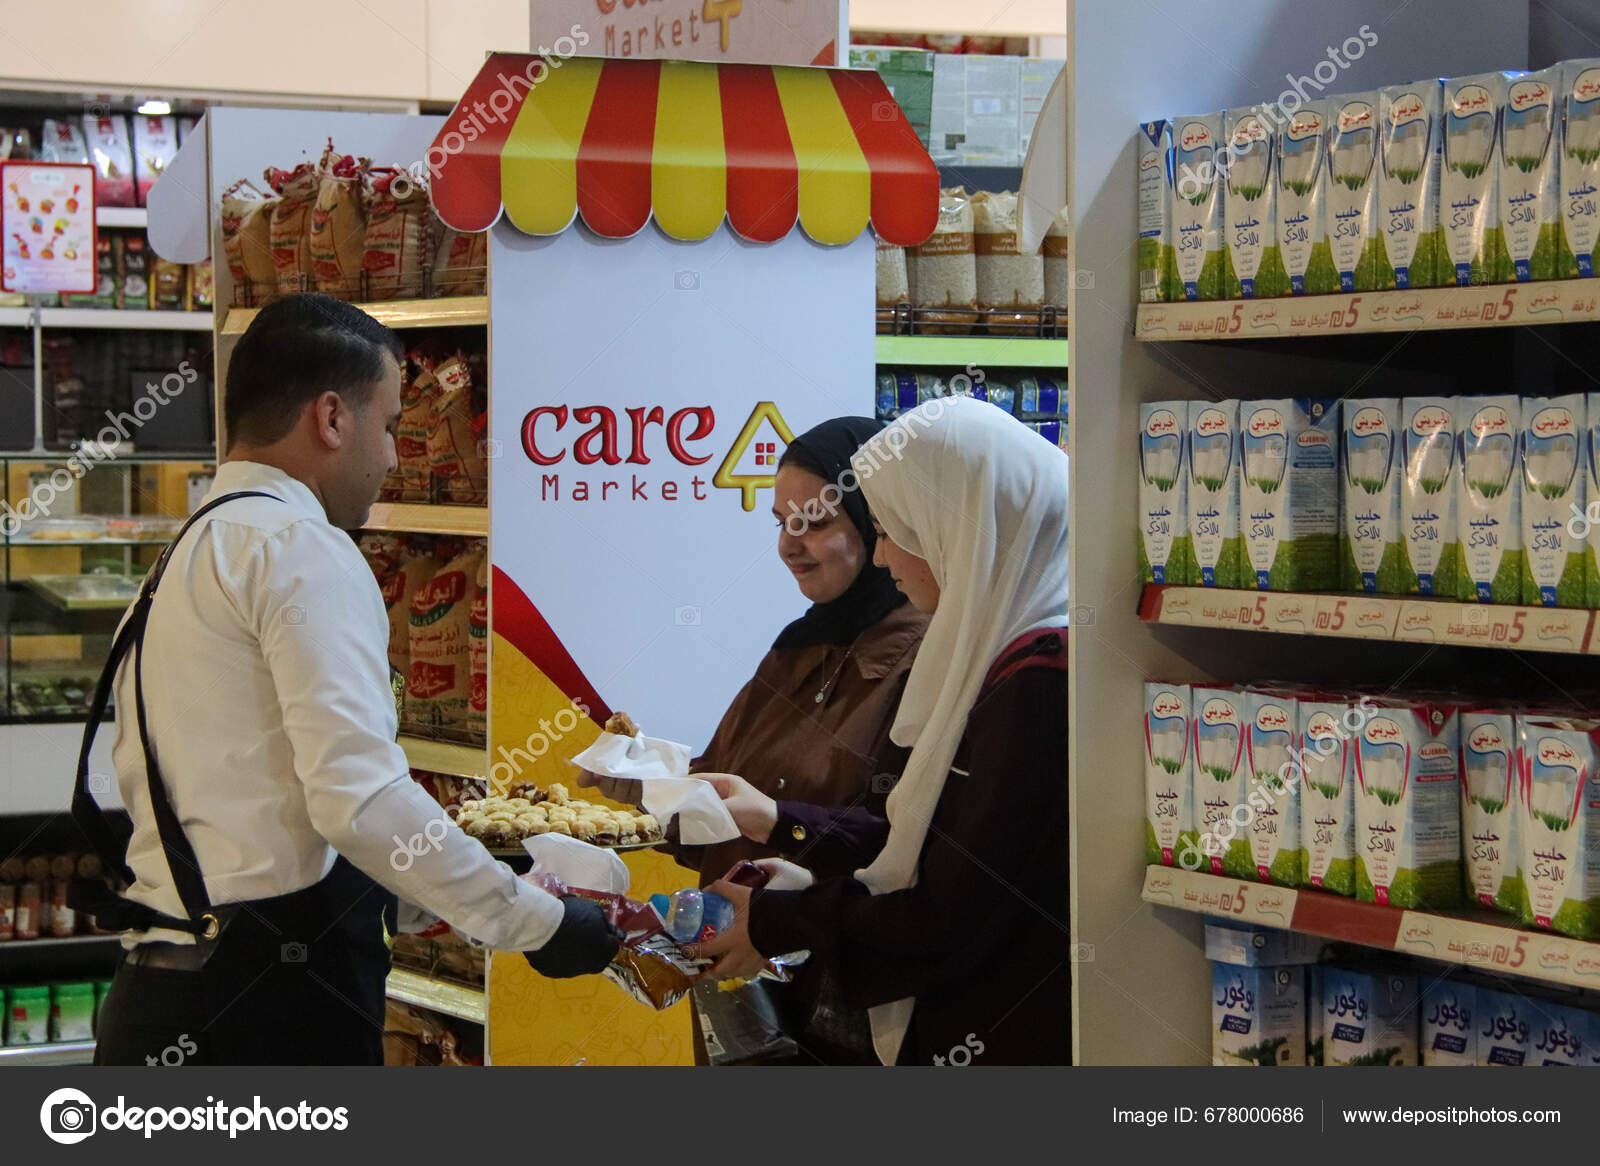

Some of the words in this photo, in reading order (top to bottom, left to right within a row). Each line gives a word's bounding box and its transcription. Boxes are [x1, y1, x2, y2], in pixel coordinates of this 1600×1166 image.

[605, 9, 700, 56] Market
[1508, 189, 1537, 204] حليب
[1568, 182, 1598, 198] حليب
[1389, 200, 1416, 215] حليب
[1451, 194, 1480, 210] حليب
[1284, 210, 1309, 225] حليب
[1335, 205, 1361, 219] حليب
[1179, 219, 1203, 233] حليب
[1234, 215, 1259, 229] حليب
[521, 404, 716, 466] care
[541, 474, 707, 501] Market
[1148, 503, 1171, 519] حليب
[1196, 503, 1220, 519] حليب
[1250, 507, 1275, 522] حليب
[1354, 508, 1381, 523] حليب
[1411, 508, 1440, 523] حليب
[1469, 513, 1500, 529] حليب
[1532, 516, 1563, 531] حليب
[1155, 787, 1179, 801] حليب
[1204, 795, 1230, 810] حليب
[1255, 804, 1279, 818] حليب
[1314, 813, 1337, 826] حليب
[1368, 820, 1396, 834] حليب
[1472, 829, 1500, 843] حليب
[1533, 847, 1567, 861] حليب
